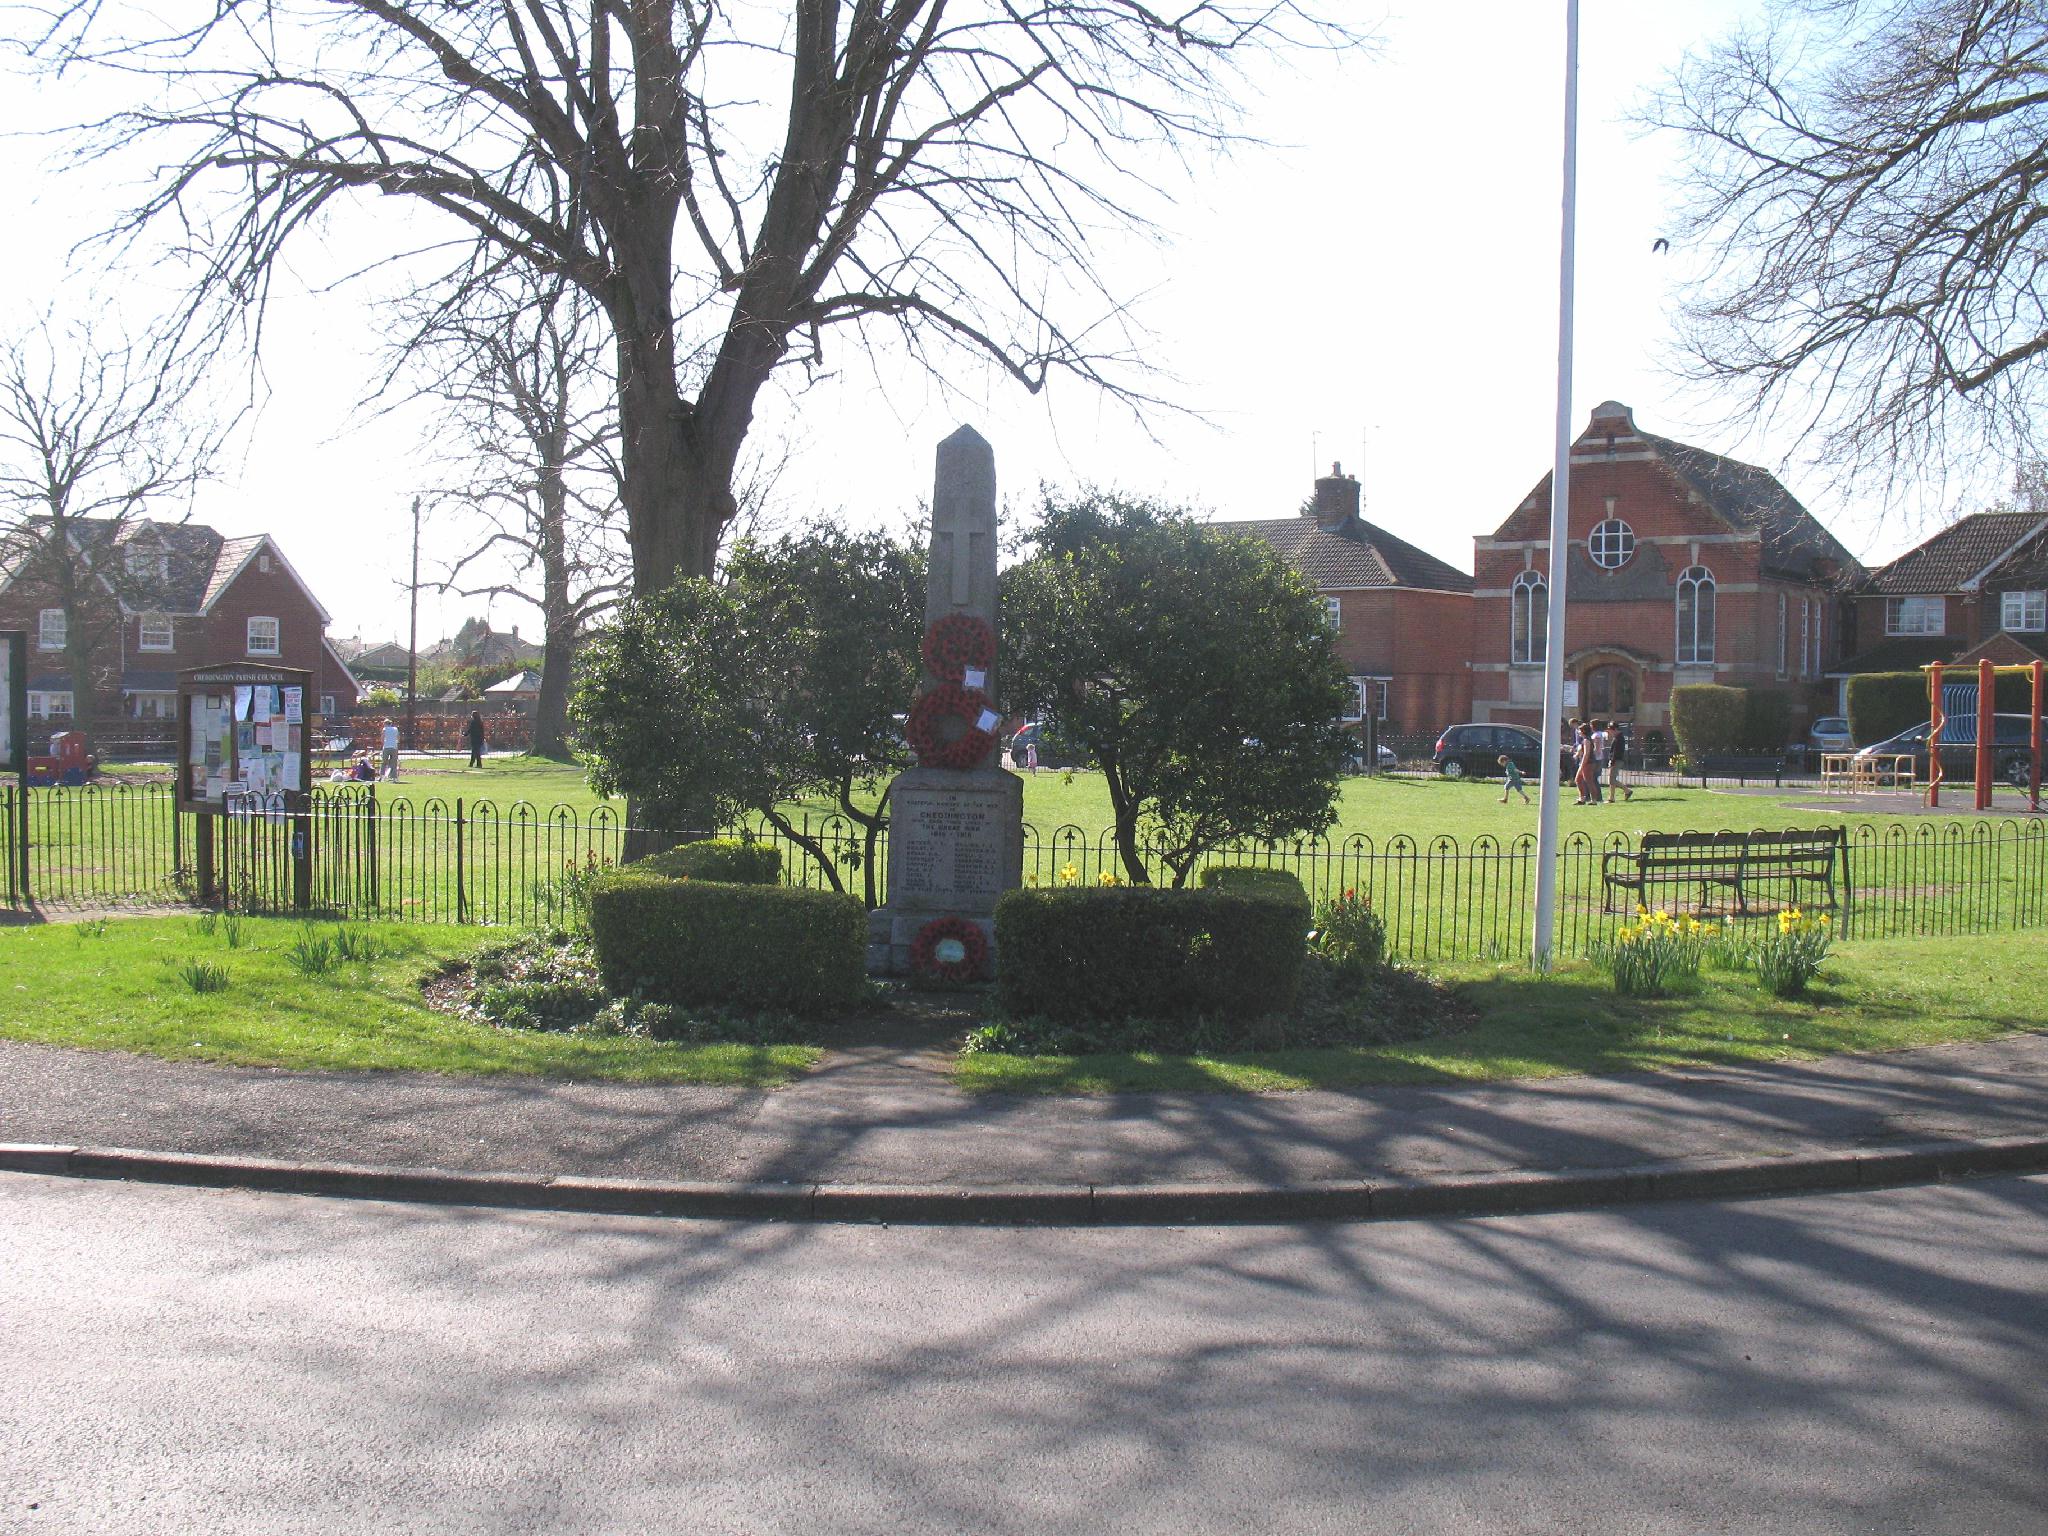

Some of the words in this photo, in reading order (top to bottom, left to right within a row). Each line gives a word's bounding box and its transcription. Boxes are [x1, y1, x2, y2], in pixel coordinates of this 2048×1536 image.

[193, 673, 234, 681] CHEDDINGTON
[236, 673, 256, 681] PARISH
[257, 673, 284, 681] COUNCIL
